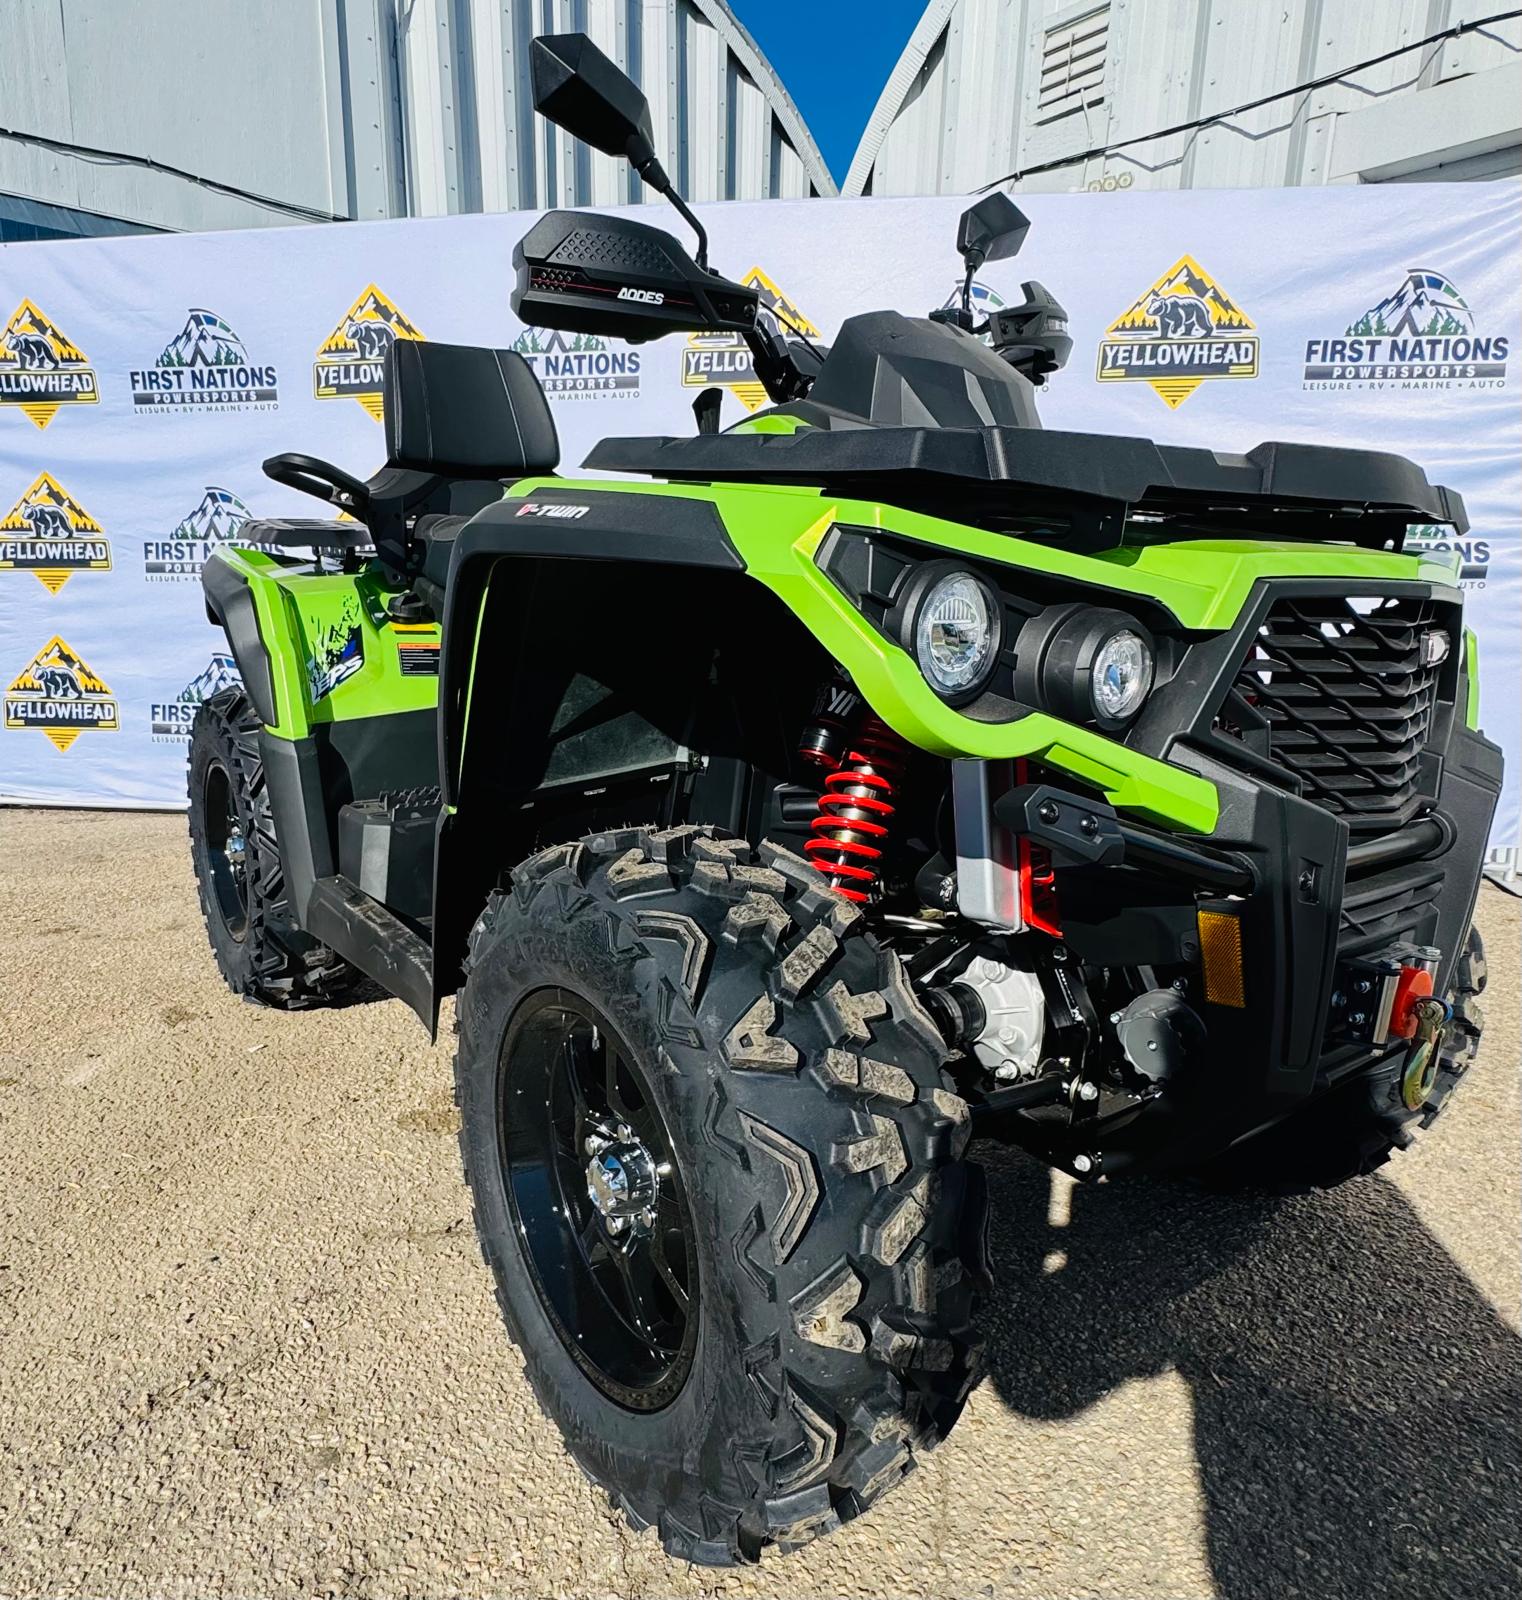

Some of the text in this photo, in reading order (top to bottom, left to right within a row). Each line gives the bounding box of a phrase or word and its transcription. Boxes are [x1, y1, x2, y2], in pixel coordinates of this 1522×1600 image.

[1103, 342, 1254, 369] YELLOWHEAD
[1305, 337, 1509, 362] FIRST NATIONS
[545, 352, 641, 376] NATIONS
[1332, 365, 1477, 379] POWERSPORTS
[0, 374, 94, 393] LLOWHEAD
[130, 366, 277, 391] FIRST NATIONS
[317, 364, 384, 388] YELLOW
[545, 378, 617, 391] RSPORTS
[1302, 380, 1506, 391] LEISURE RV MARINE AUTO
[154, 391, 257, 404] POWERSPORTS
[558, 390, 640, 401] MARINE AUTO
[254, 403, 279, 411] AUTO
[144, 542, 197, 560] FIRST
[145, 575, 180, 583] LEISURE
[7, 702, 115, 720] YELLOWHEAD
